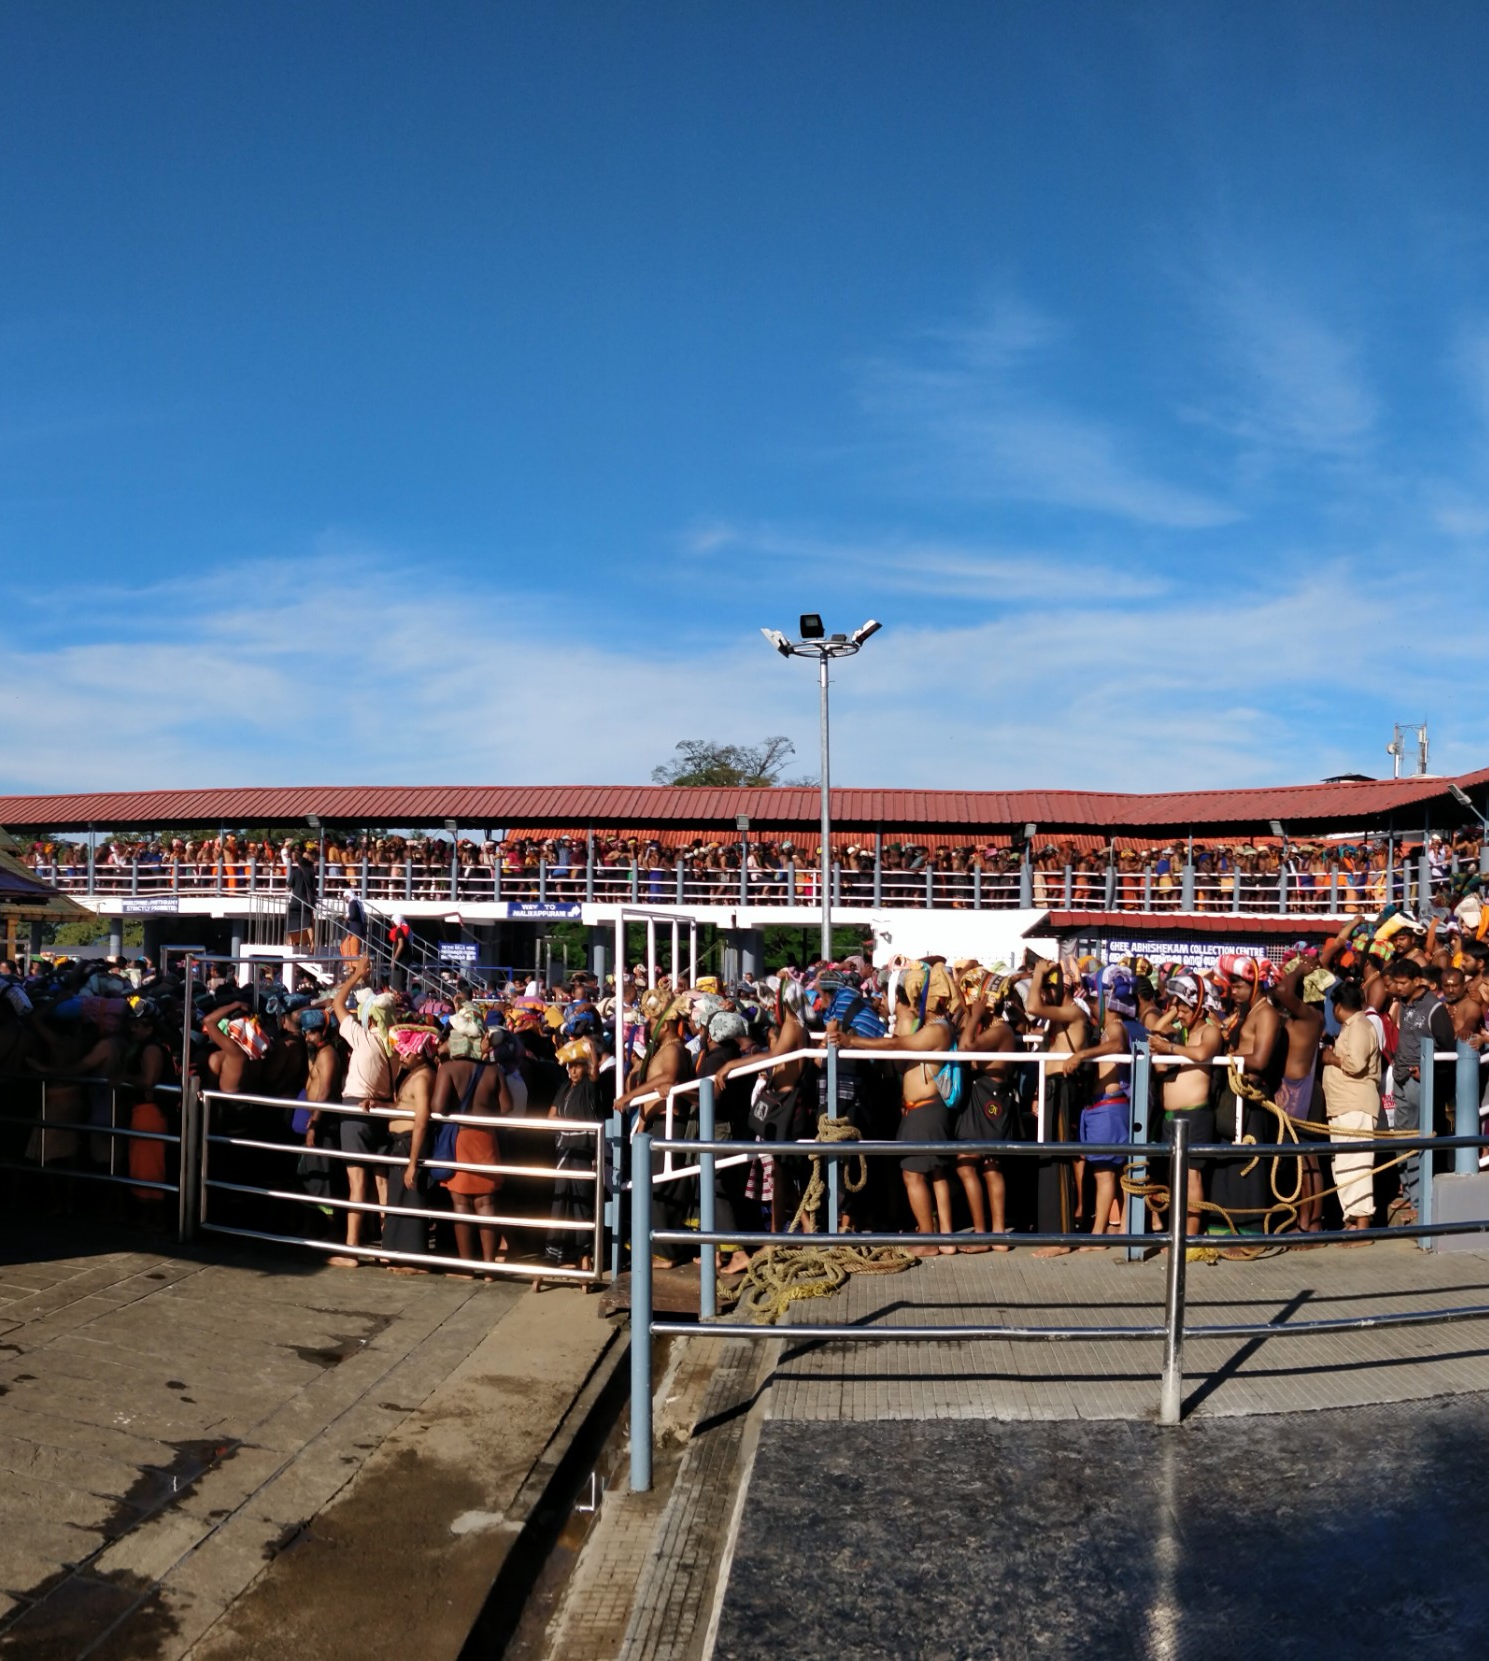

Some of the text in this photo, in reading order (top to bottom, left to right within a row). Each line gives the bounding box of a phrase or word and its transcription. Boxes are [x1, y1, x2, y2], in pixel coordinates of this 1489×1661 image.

[1110, 941, 1265, 957] GHEE ABHISHEKAM COLLECTION CENTRE
